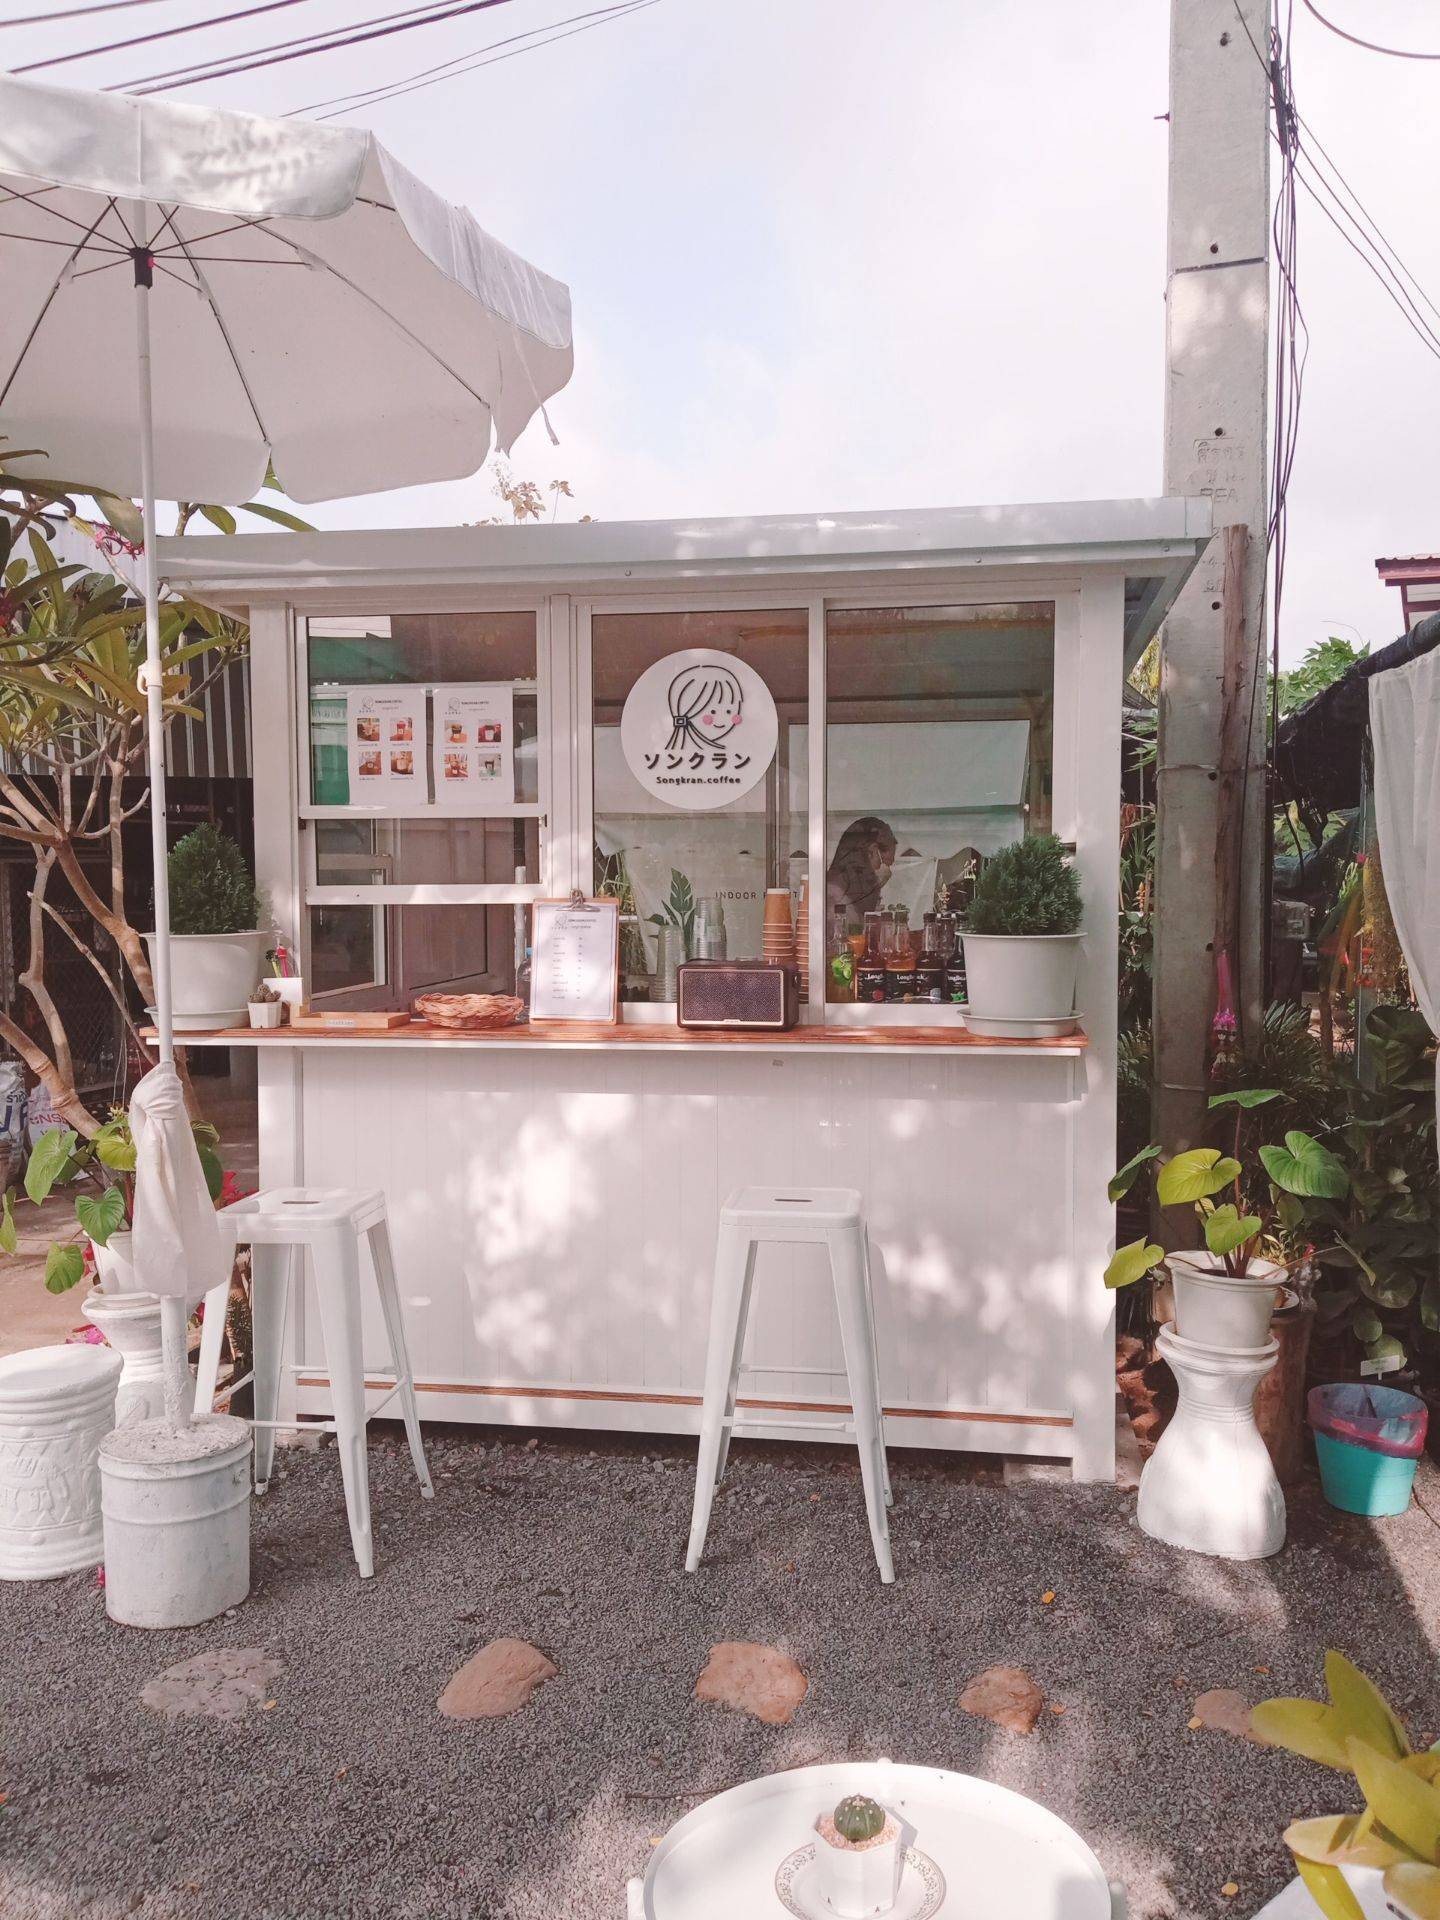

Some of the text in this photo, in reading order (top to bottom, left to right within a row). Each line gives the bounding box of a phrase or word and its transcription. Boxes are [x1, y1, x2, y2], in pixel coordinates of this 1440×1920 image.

[644, 752, 751, 770] ソンクラン
[656, 776, 742, 786] Songkran.coffee
[715, 891, 757, 900] INDOOR
